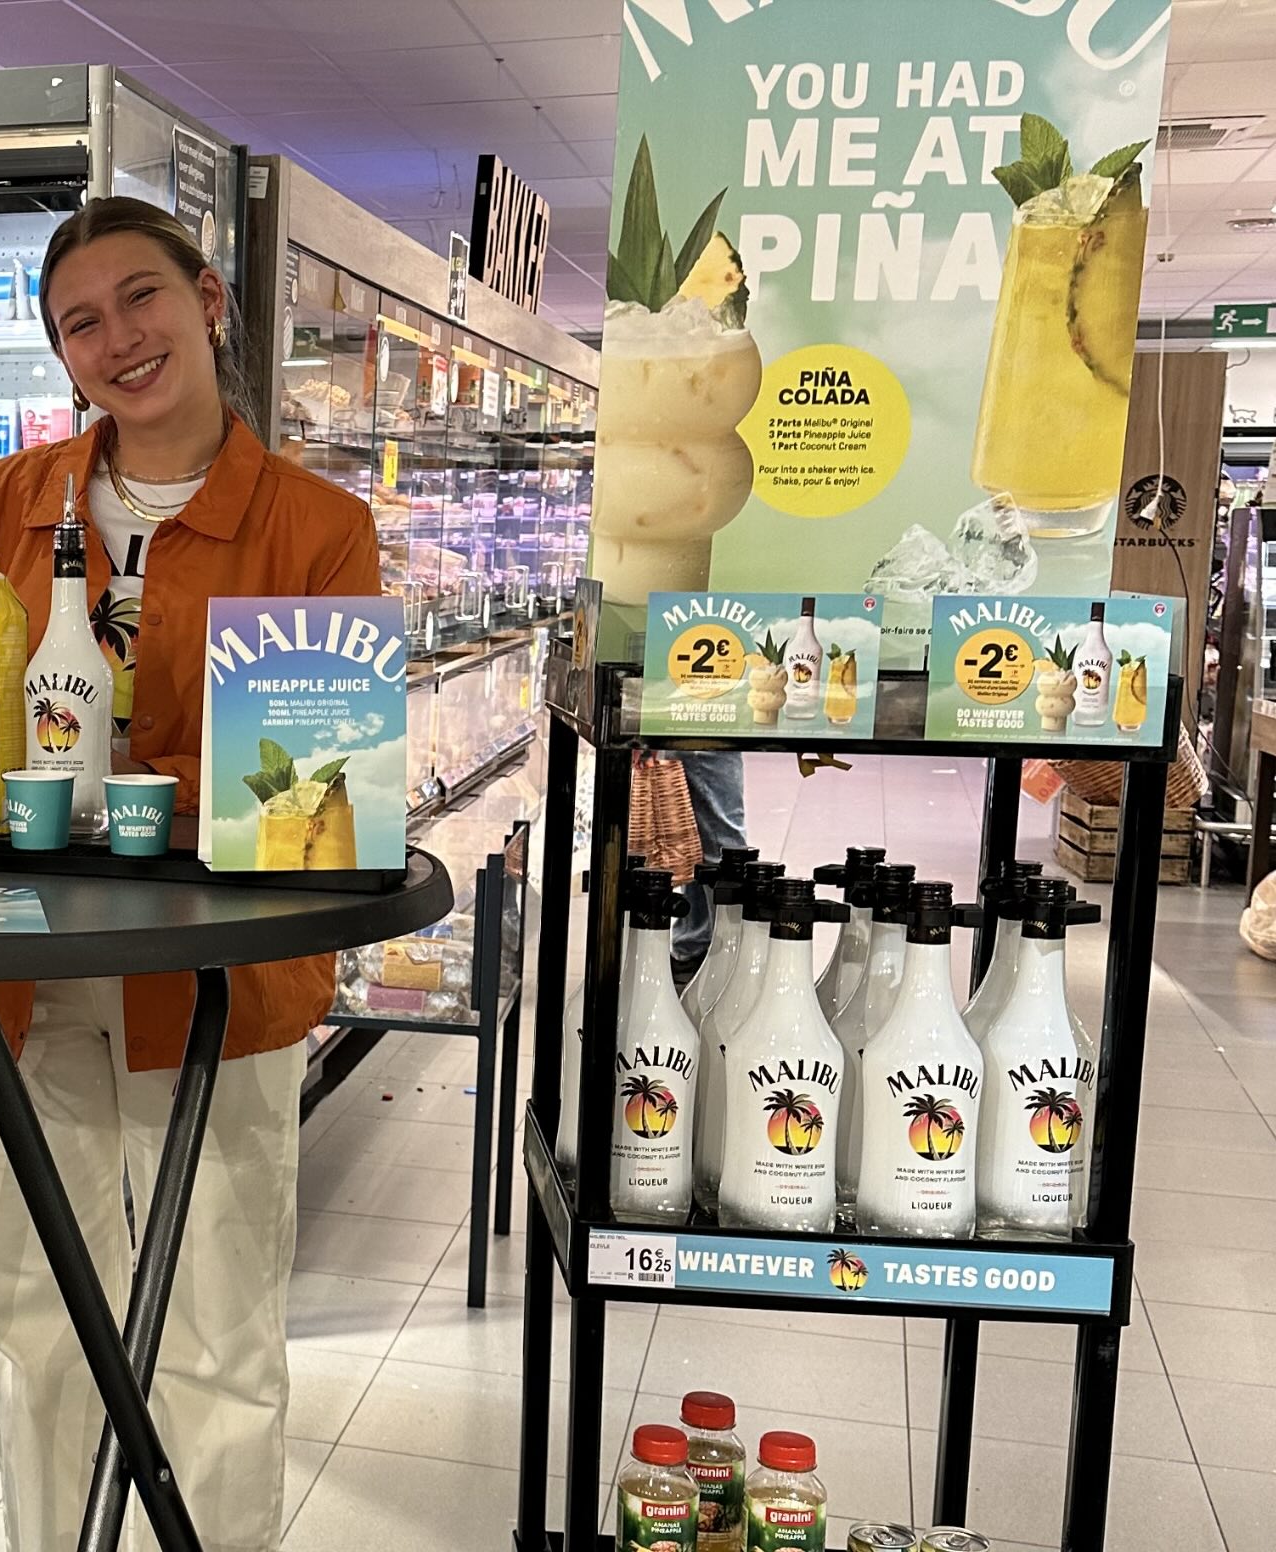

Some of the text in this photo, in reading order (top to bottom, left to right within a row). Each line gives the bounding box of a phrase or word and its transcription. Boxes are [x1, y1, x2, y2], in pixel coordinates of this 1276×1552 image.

[746, 59, 1025, 111] YOU HAD
[743, 115, 1023, 188] ME AT
[738, 190, 1002, 302] PIÑA
[799, 366, 852, 388] PIÑA
[778, 388, 870, 406] COLADA
[768, 418, 775, 428] 2
[777, 418, 802, 428] Parts
[840, 417, 874, 429] Original
[768, 430, 872, 441] 3 Parts Pineapple Juice
[772, 442, 867, 451] 1 Part Coconut Cream
[759, 465, 779, 474] Pour
[780, 465, 798, 474] into
[807, 465, 837, 474] shaker
[839, 465, 859, 474] with
[772, 477, 860, 488] Shake, pour & enjoy!
[1113, 537, 1196, 548] STARBUCKS
[662, 597, 763, 632] MALIBU
[949, 601, 1052, 637] MALIBU
[210, 609, 406, 686] MALIBU
[25, 672, 100, 705] MALIBU
[247, 678, 371, 693] PINEAPPLE JUICE
[290, 699, 316, 707] MALIBU
[317, 698, 349, 707] ORIGINAL
[685, 703, 737, 713] WHATEVER
[267, 708, 351, 717] 100ML PINEAPPLE JUICE
[670, 712, 736, 723] TASTES GOOD
[956, 708, 1025, 719] DO WHATEVER
[262, 718, 294, 726] GARNISH
[294, 718, 332, 726] PINEAPPLE
[956, 718, 1025, 729] TASTES GOOD
[110, 804, 166, 825] MALIBU
[615, 1045, 696, 1081] MALIBU
[747, 1058, 841, 1095] MALIBU
[1008, 1056, 1096, 1092] MALIBU
[886, 1063, 981, 1100] MALIBU
[633, 1145, 650, 1153] WITH
[775, 1161, 793, 1169] WITH
[628, 1177, 668, 1187] LIQUEUR
[770, 1195, 813, 1205] LIQUEUR
[1031, 1193, 1073, 1203] LIQUEUR
[911, 1200, 953, 1210] LIQUEUR
[625, 1247, 652, 1271] 16
[654, 1259, 672, 1272] 25
[677, 1249, 1056, 1292] WHATEVER TASTES GOOD
[689, 1465, 730, 1478] granini
[645, 1504, 687, 1517] granini
[769, 1510, 812, 1524] granini
[653, 1521, 680, 1529] ANANAS
[774, 1533, 807, 1541] PINEAPPLE
